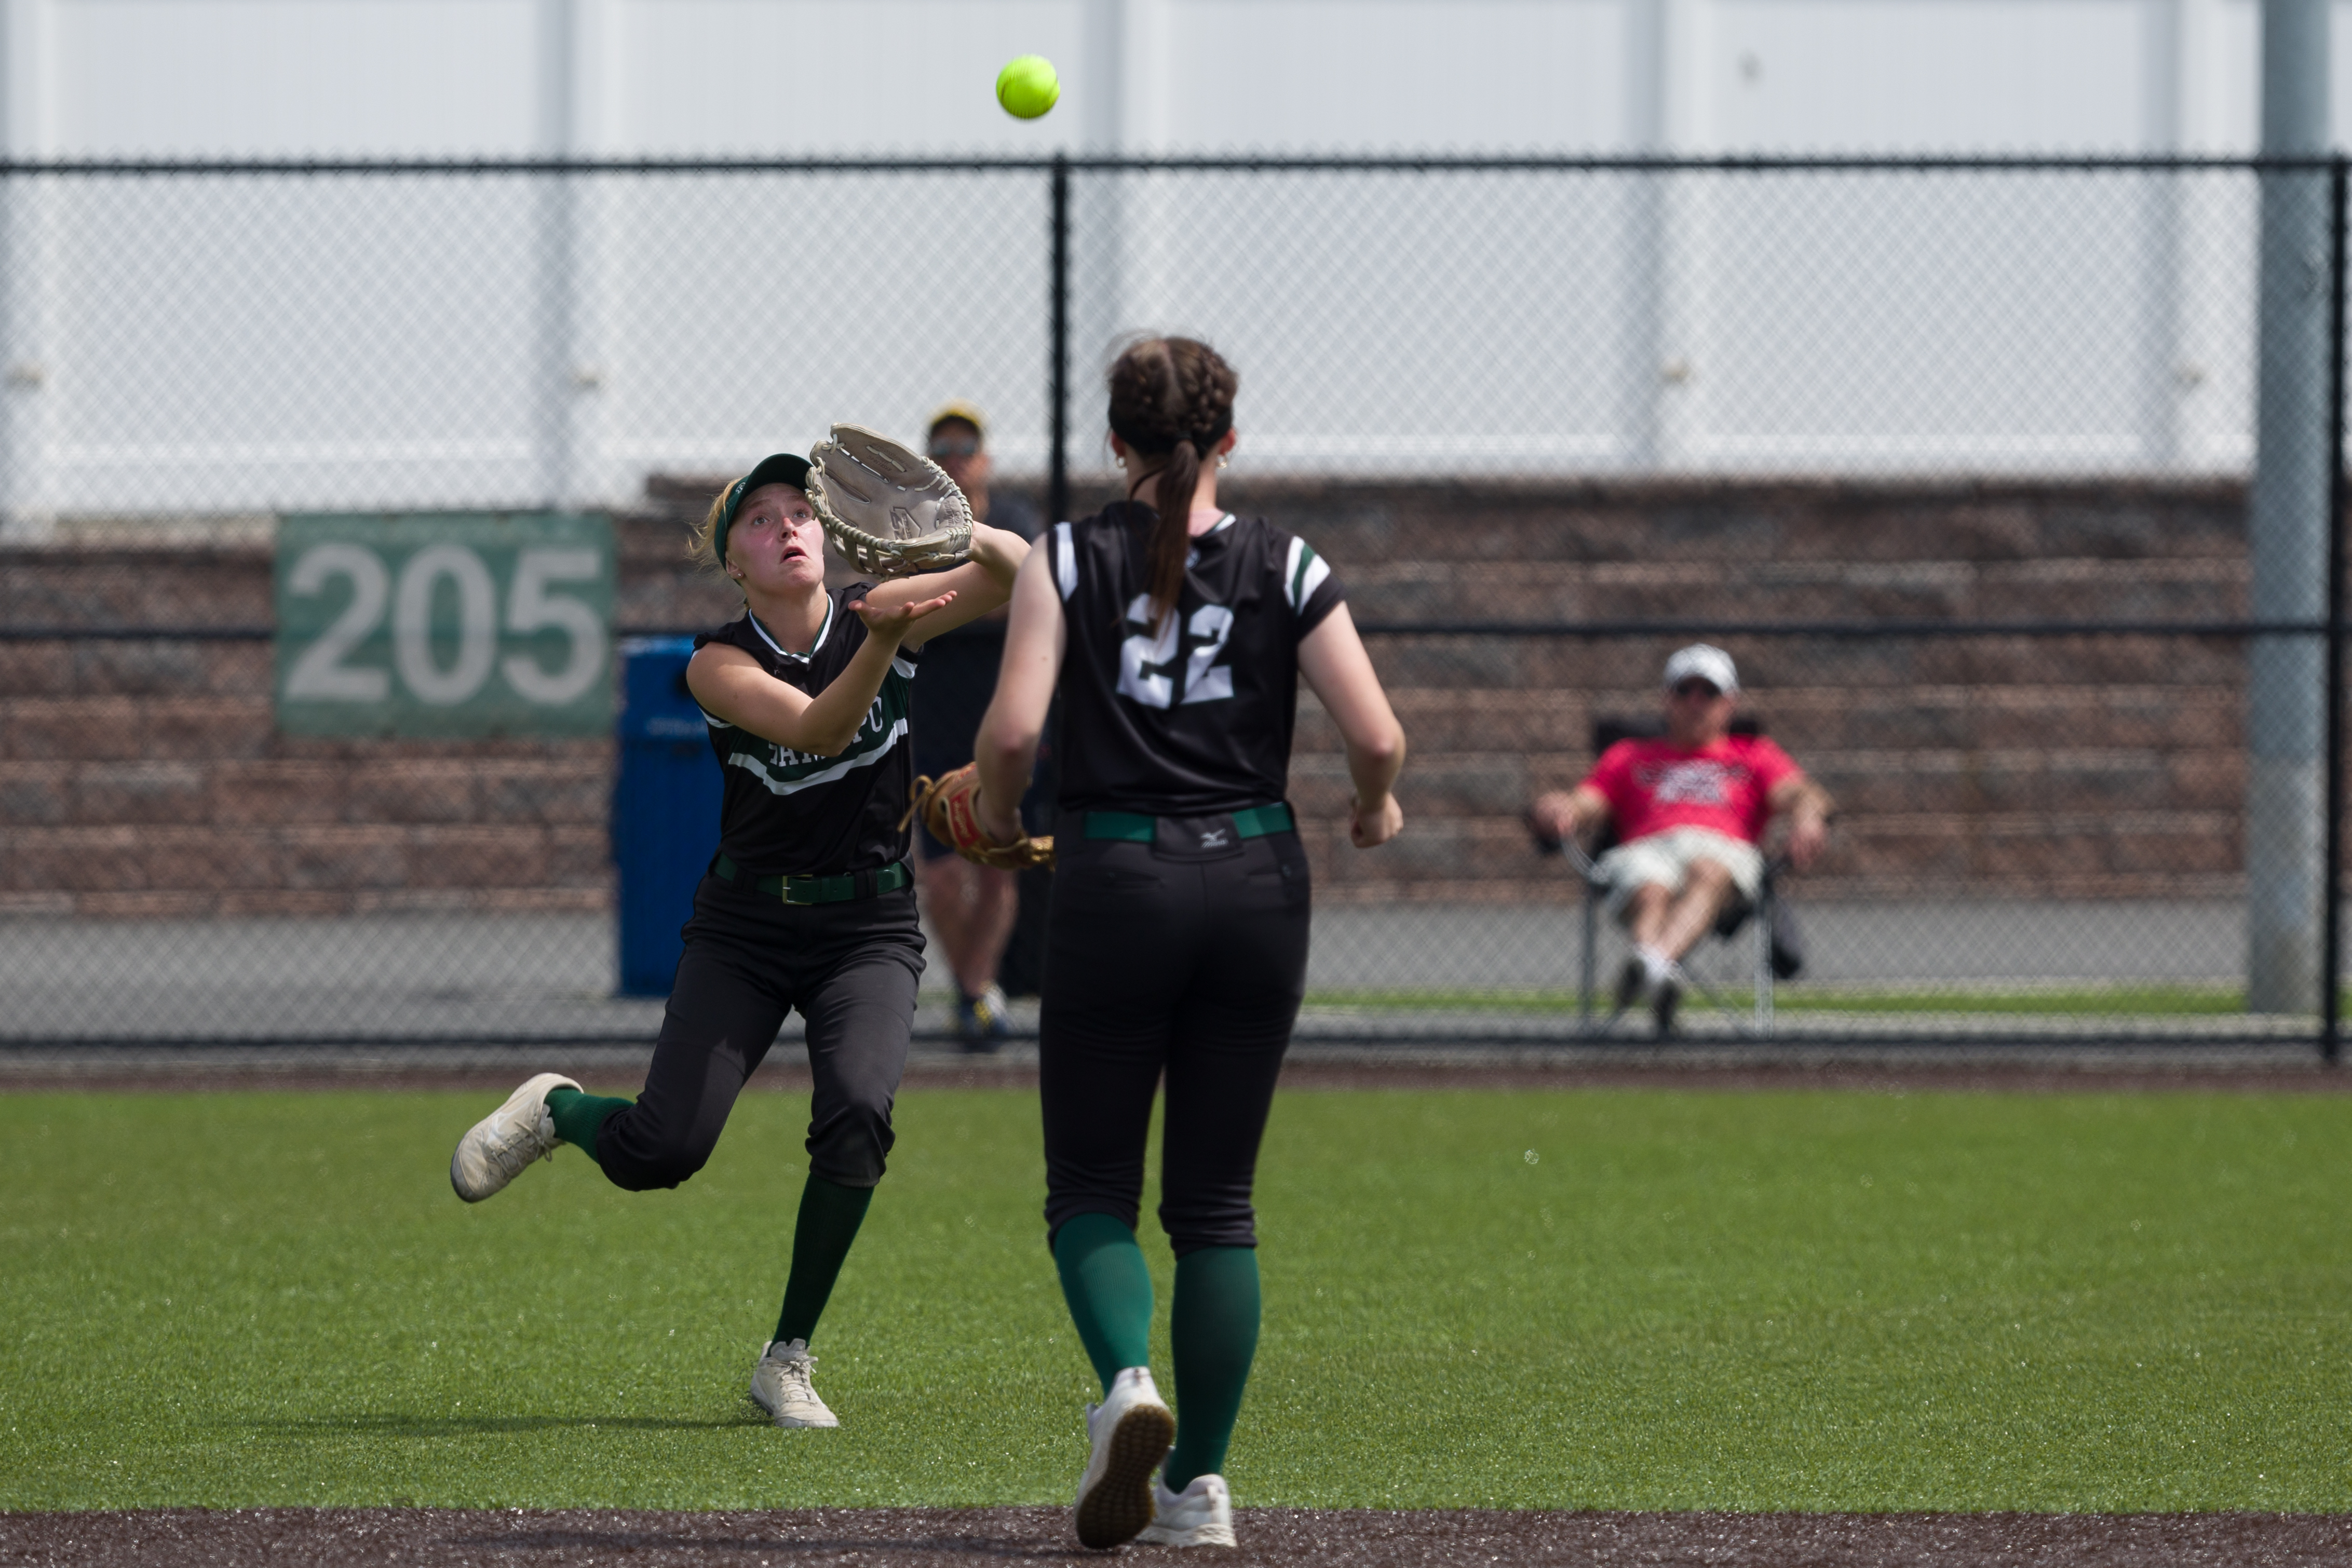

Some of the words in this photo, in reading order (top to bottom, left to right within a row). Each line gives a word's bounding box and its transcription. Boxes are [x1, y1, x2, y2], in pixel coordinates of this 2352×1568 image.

[902, 513, 912, 539] ERIES
[285, 542, 609, 706] 205
[1116, 592, 1234, 709] 22
